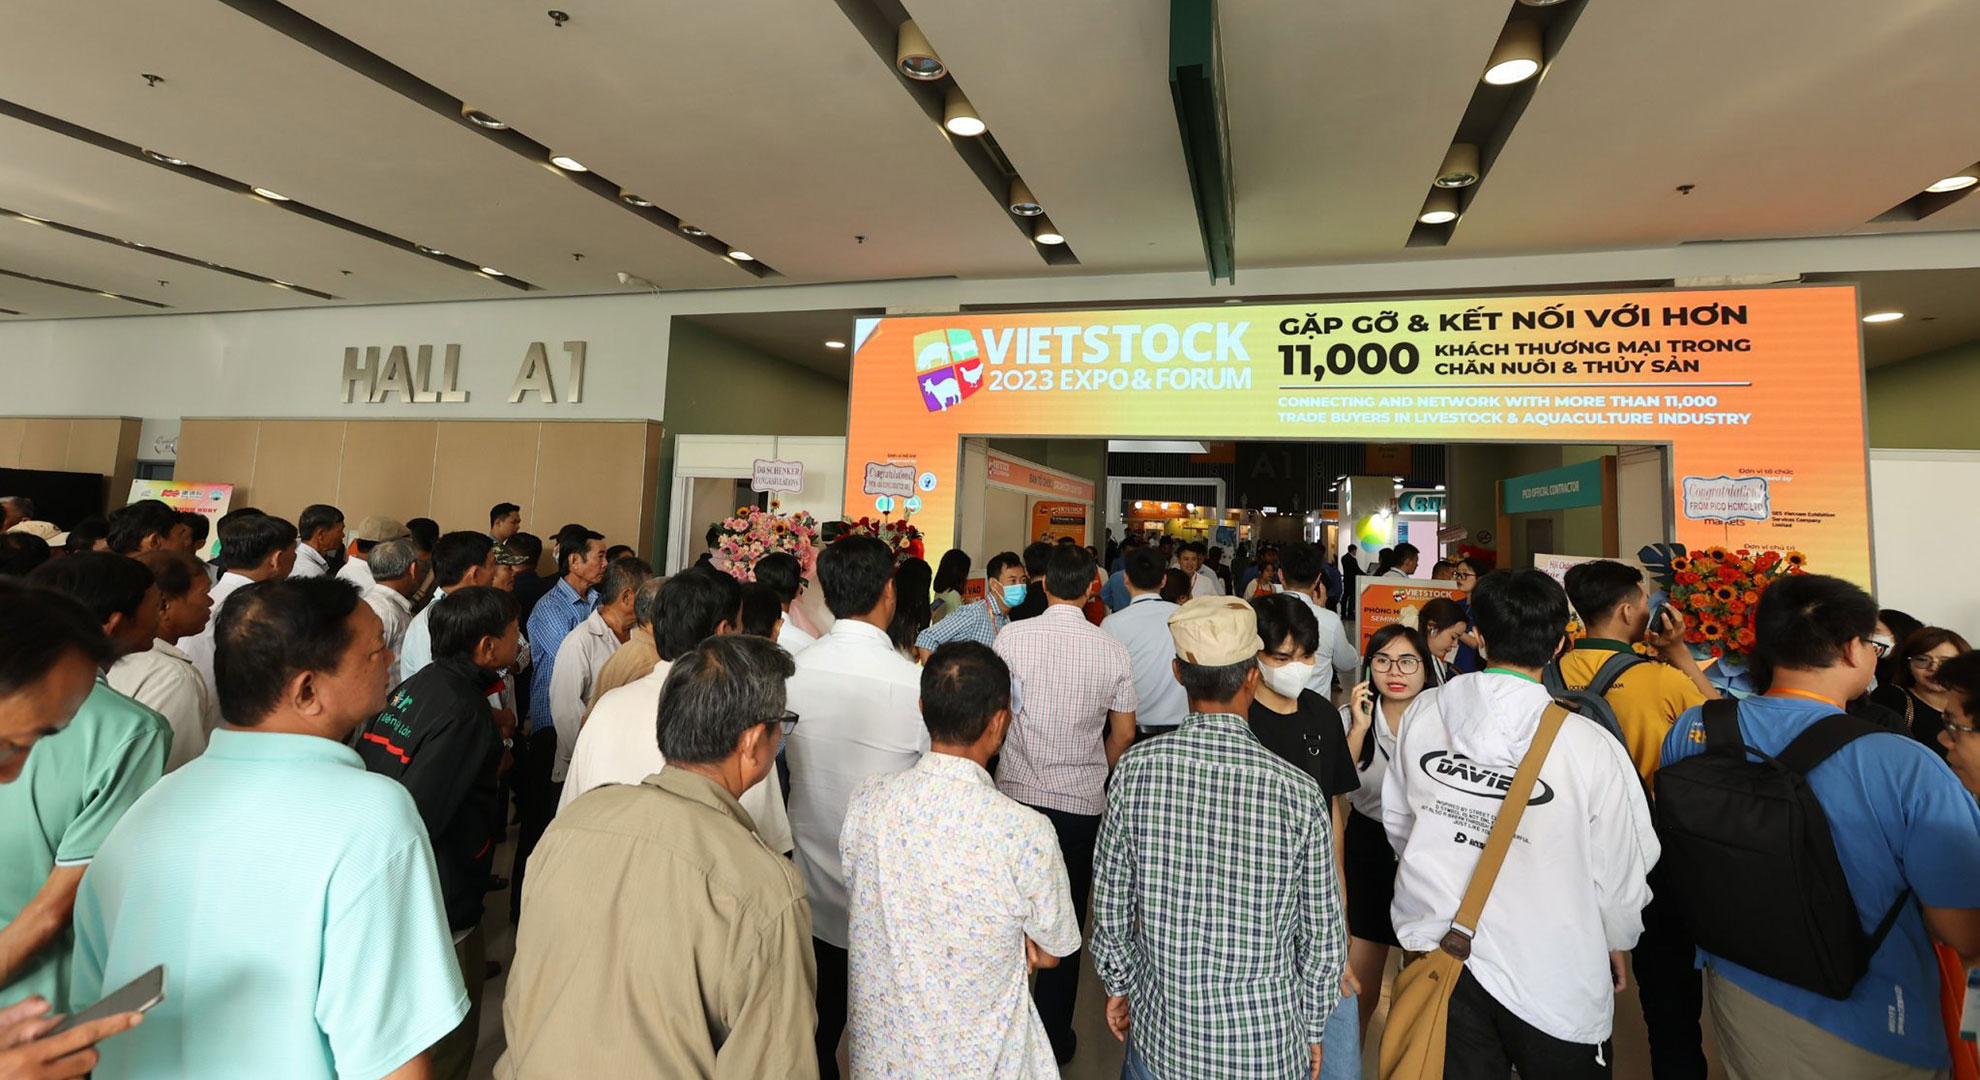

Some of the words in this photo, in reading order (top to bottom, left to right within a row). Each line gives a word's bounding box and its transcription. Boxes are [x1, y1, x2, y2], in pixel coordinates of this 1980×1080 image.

[1279, 312, 1343, 340] GẶP
[1352, 310, 1399, 334] GỠ
[1407, 314, 1429, 333] &
[1439, 306, 1502, 332] KẾT
[1513, 303, 1574, 330] NỐI
[1585, 303, 1650, 328] VỚI
[1663, 302, 1747, 327] HƠN
[981, 321, 1251, 365] VIETSTOCK
[1434, 341, 1509, 357] KHÁCH
[1515, 340, 1611, 355] THƯƠNG
[1617, 340, 1661, 357] MẠI
[1667, 339, 1751, 352] TRONG
[1278, 341, 1420, 382] 11,000
[1434, 357, 1494, 375] CHĂN
[1501, 358, 1556, 375] NUÔI
[1562, 361, 1577, 374] &
[1583, 356, 1646, 374] THỦY
[1651, 355, 1700, 373] SẢN
[340, 343, 471, 404] HALL
[508, 340, 588, 404] A1
[988, 369, 1054, 391] 2023
[1060, 368, 1128, 390] EXPO
[1132, 368, 1152, 390] &
[1157, 367, 1252, 389] FORUM
[1278, 396, 1375, 407] CONNECTING
[1379, 396, 1413, 407] AND
[1417, 396, 1501, 407] NETWORK
[1505, 395, 1550, 407] WITH
[1555, 395, 1606, 407] MORE
[1610, 395, 1660, 406] THAN
[1664, 395, 1718, 408] 11,000
[1278, 412, 1328, 423] TRADE
[1331, 412, 1391, 423] BUYERS
[1395, 412, 1411, 423] IN
[1415, 412, 1503, 423] LIVESTOCK
[1507, 412, 1519, 423] &
[1522, 412, 1654, 425] AQUACULTURE
[1658, 412, 1751, 424] INDUSTRY
[1549, 481, 1579, 496] CONTRACTOR
[1690, 502, 1709, 511] FROM
[1711, 502, 1727, 511] PICO
[1728, 502, 1749, 512] HCMC
[1405, 588, 1453, 600] VIETSTOCK
